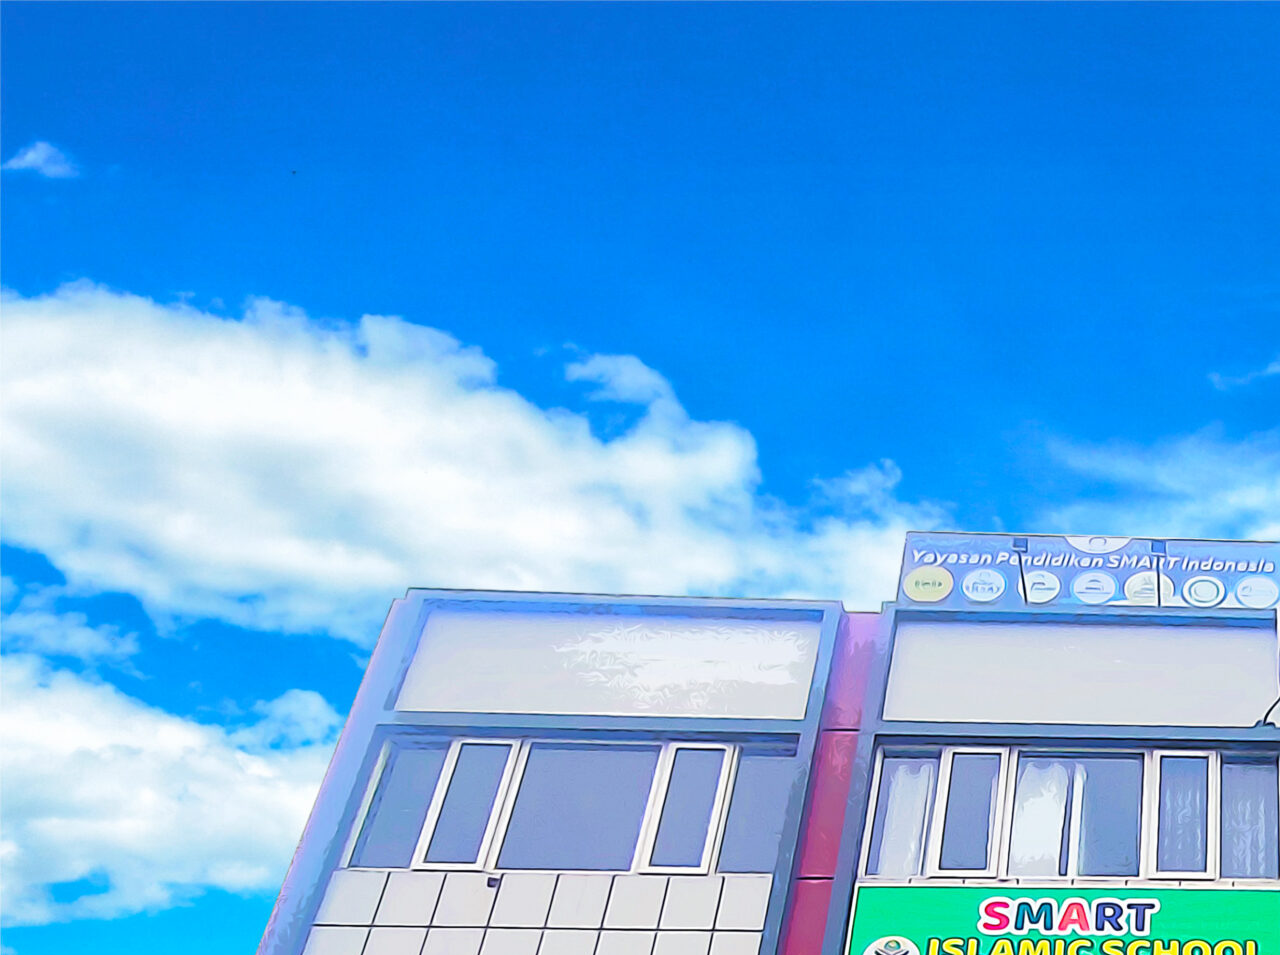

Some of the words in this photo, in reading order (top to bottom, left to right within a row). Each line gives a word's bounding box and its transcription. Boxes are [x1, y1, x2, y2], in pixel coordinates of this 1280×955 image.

[912, 549, 993, 567] Yayasan
[995, 551, 1104, 568] Pendidikan
[1180, 557, 1276, 574] Indonesia
[981, 900, 1158, 933] SMART
